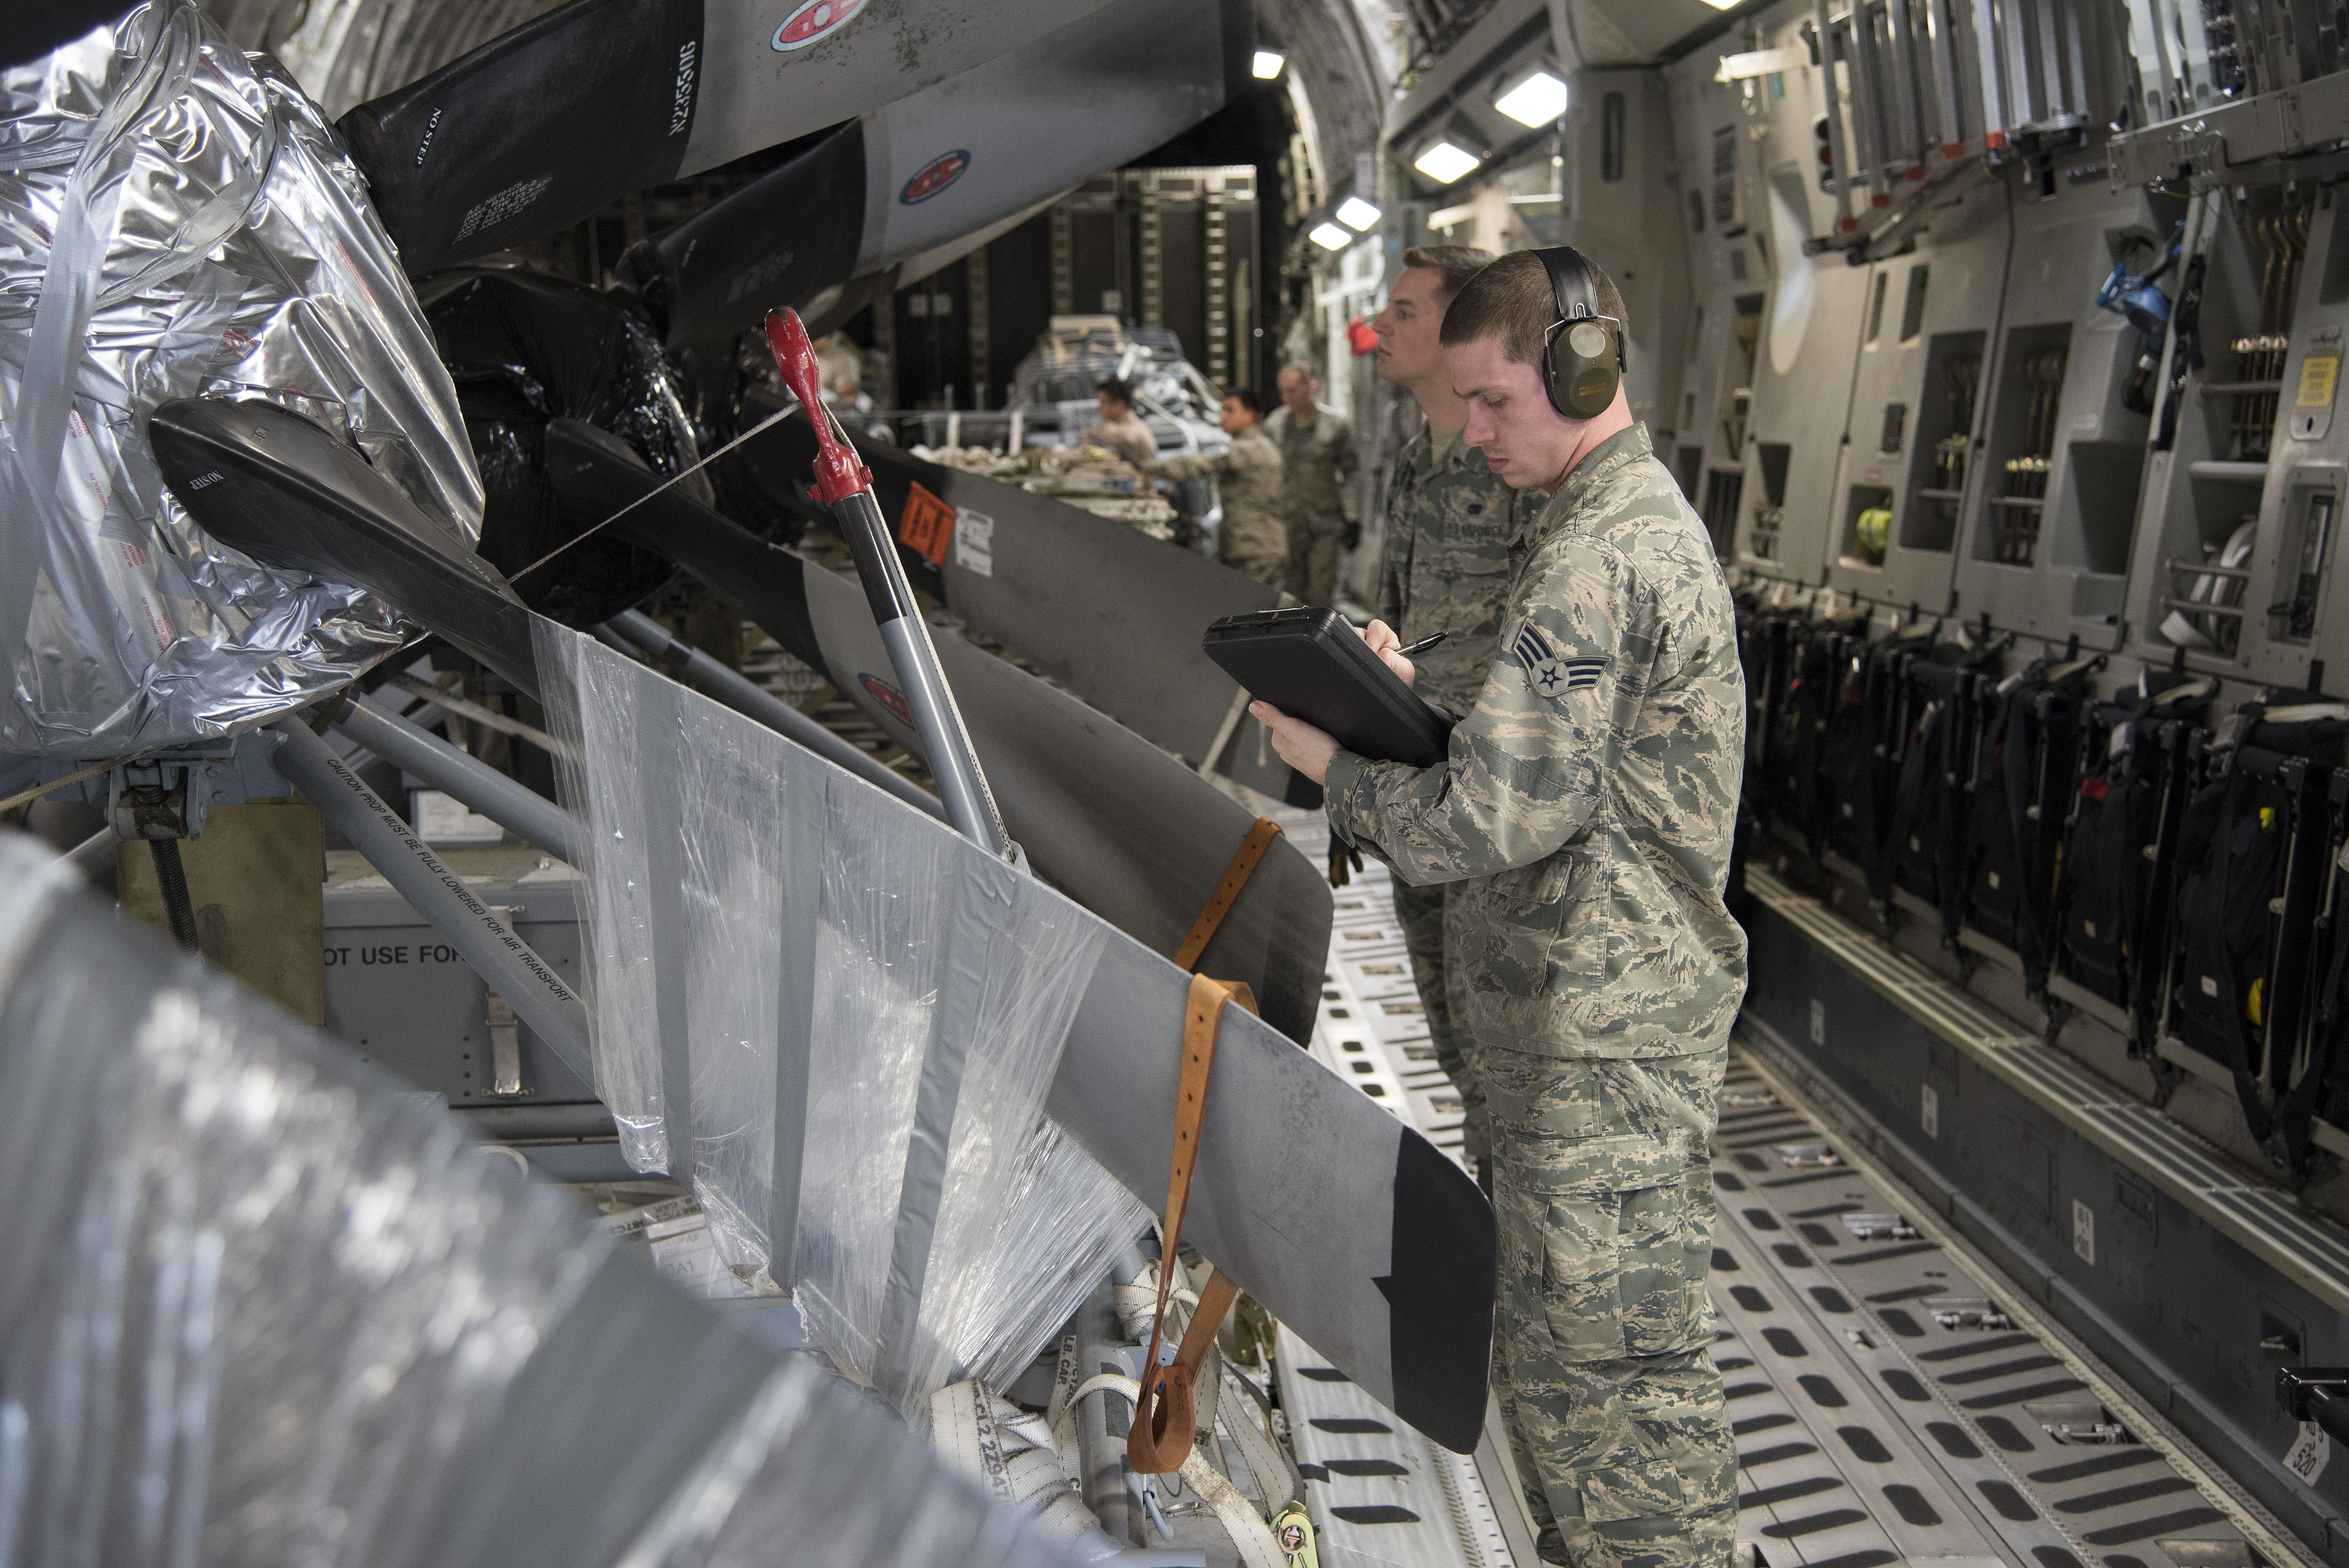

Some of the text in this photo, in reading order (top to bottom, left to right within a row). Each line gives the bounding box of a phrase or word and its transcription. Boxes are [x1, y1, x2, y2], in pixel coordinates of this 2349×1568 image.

[668, 41, 696, 136] N235506
[417, 107, 441, 165] NO STEP
[189, 470, 225, 490] NO STEP
[157, 619, 169, 644] PRODUCTS
[328, 759, 574, 1001] CAUTION PROP MUST BE FULLY LOWERED FOR AIR TRANSPORT
[361, 946, 408, 965] USE
[1062, 1336, 1075, 1355] LB.
[1057, 1359, 1070, 1385] CAP.
